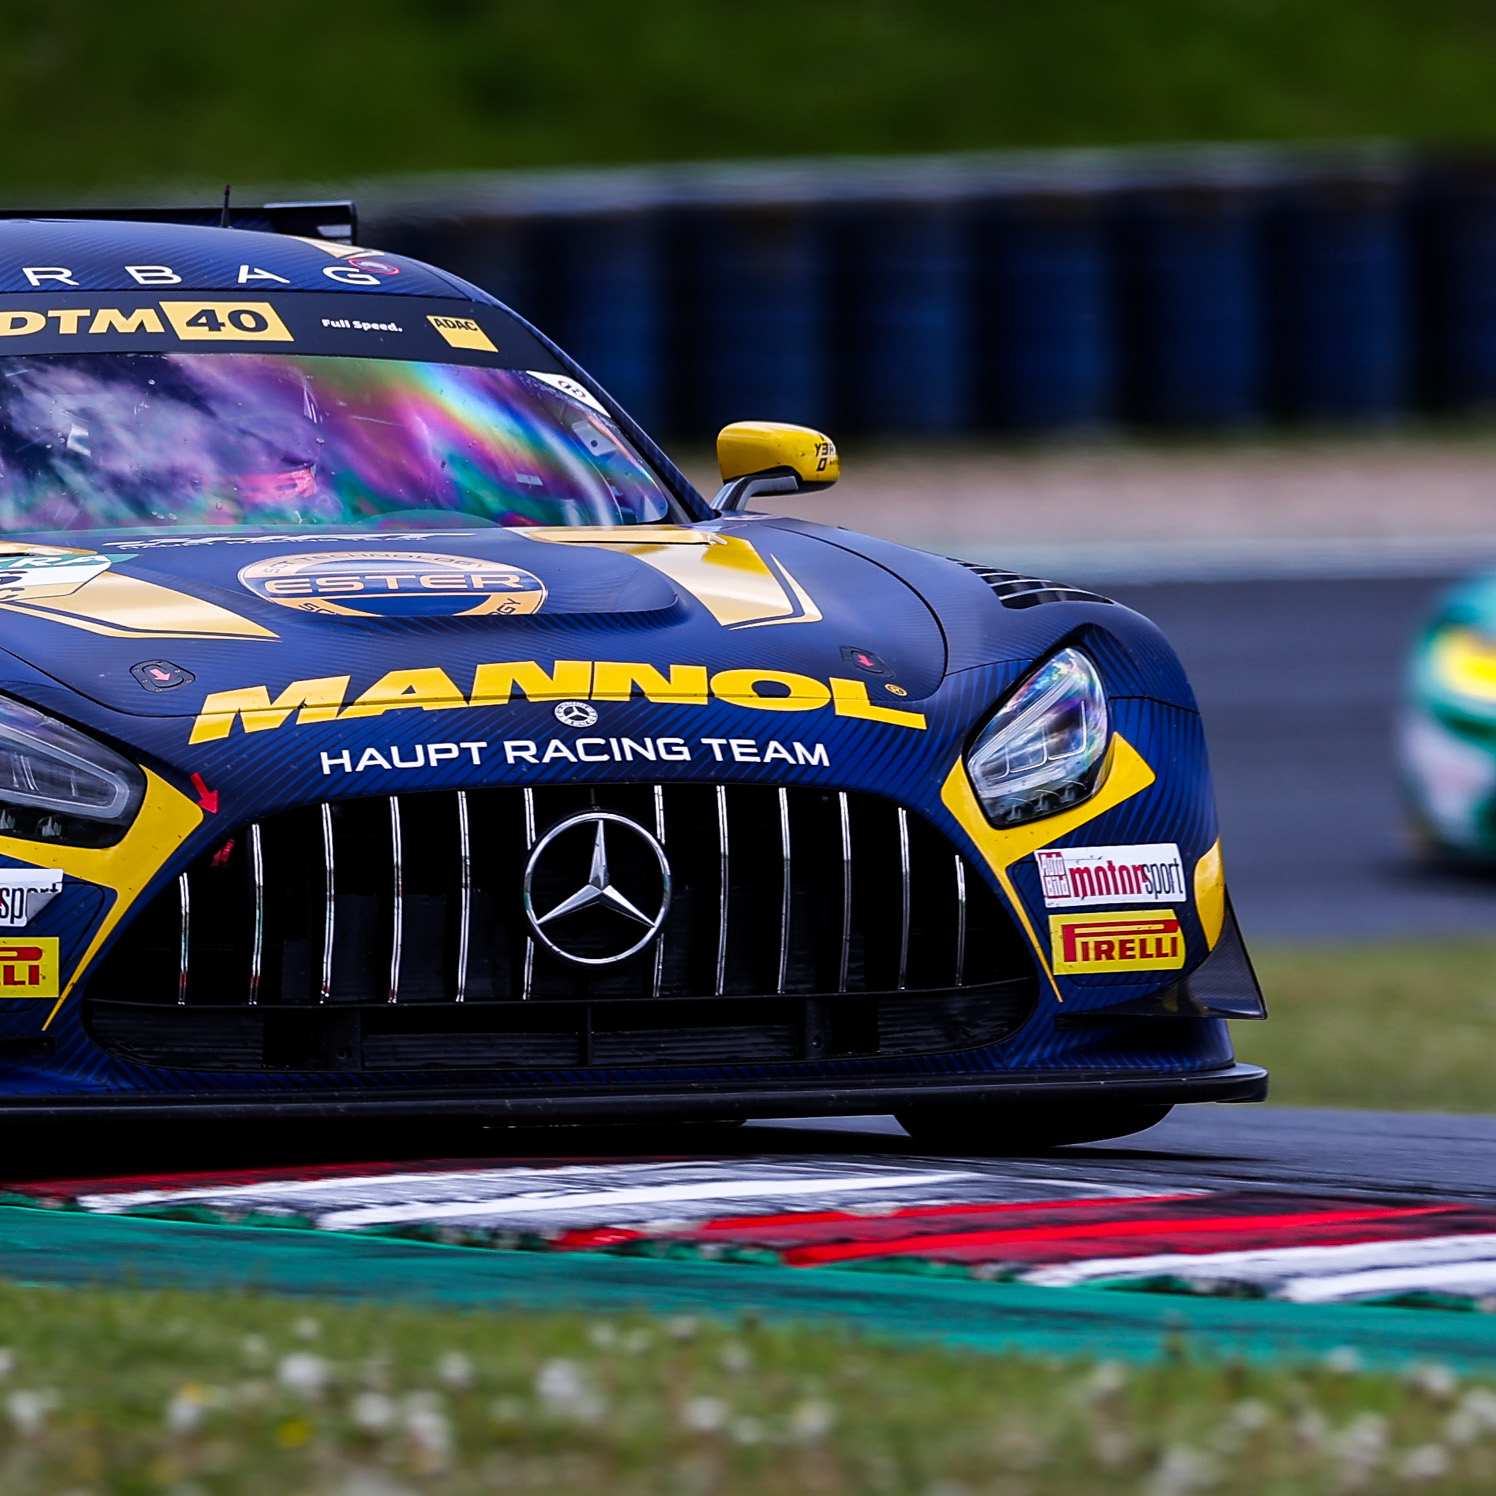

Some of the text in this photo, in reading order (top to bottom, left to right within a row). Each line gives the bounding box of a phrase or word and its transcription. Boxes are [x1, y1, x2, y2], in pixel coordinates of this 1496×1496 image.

[185, 308, 269, 333] 40
[321, 318, 403, 333] Full Speed.
[433, 317, 478, 332] ADAC
[264, 574, 524, 594] ESTER
[188, 660, 927, 745] MANNOL
[319, 736, 831, 775] HAUPT RACING TEAM
[1069, 858, 1184, 900] motorsport
[1061, 918, 1179, 963] PIRELLI
